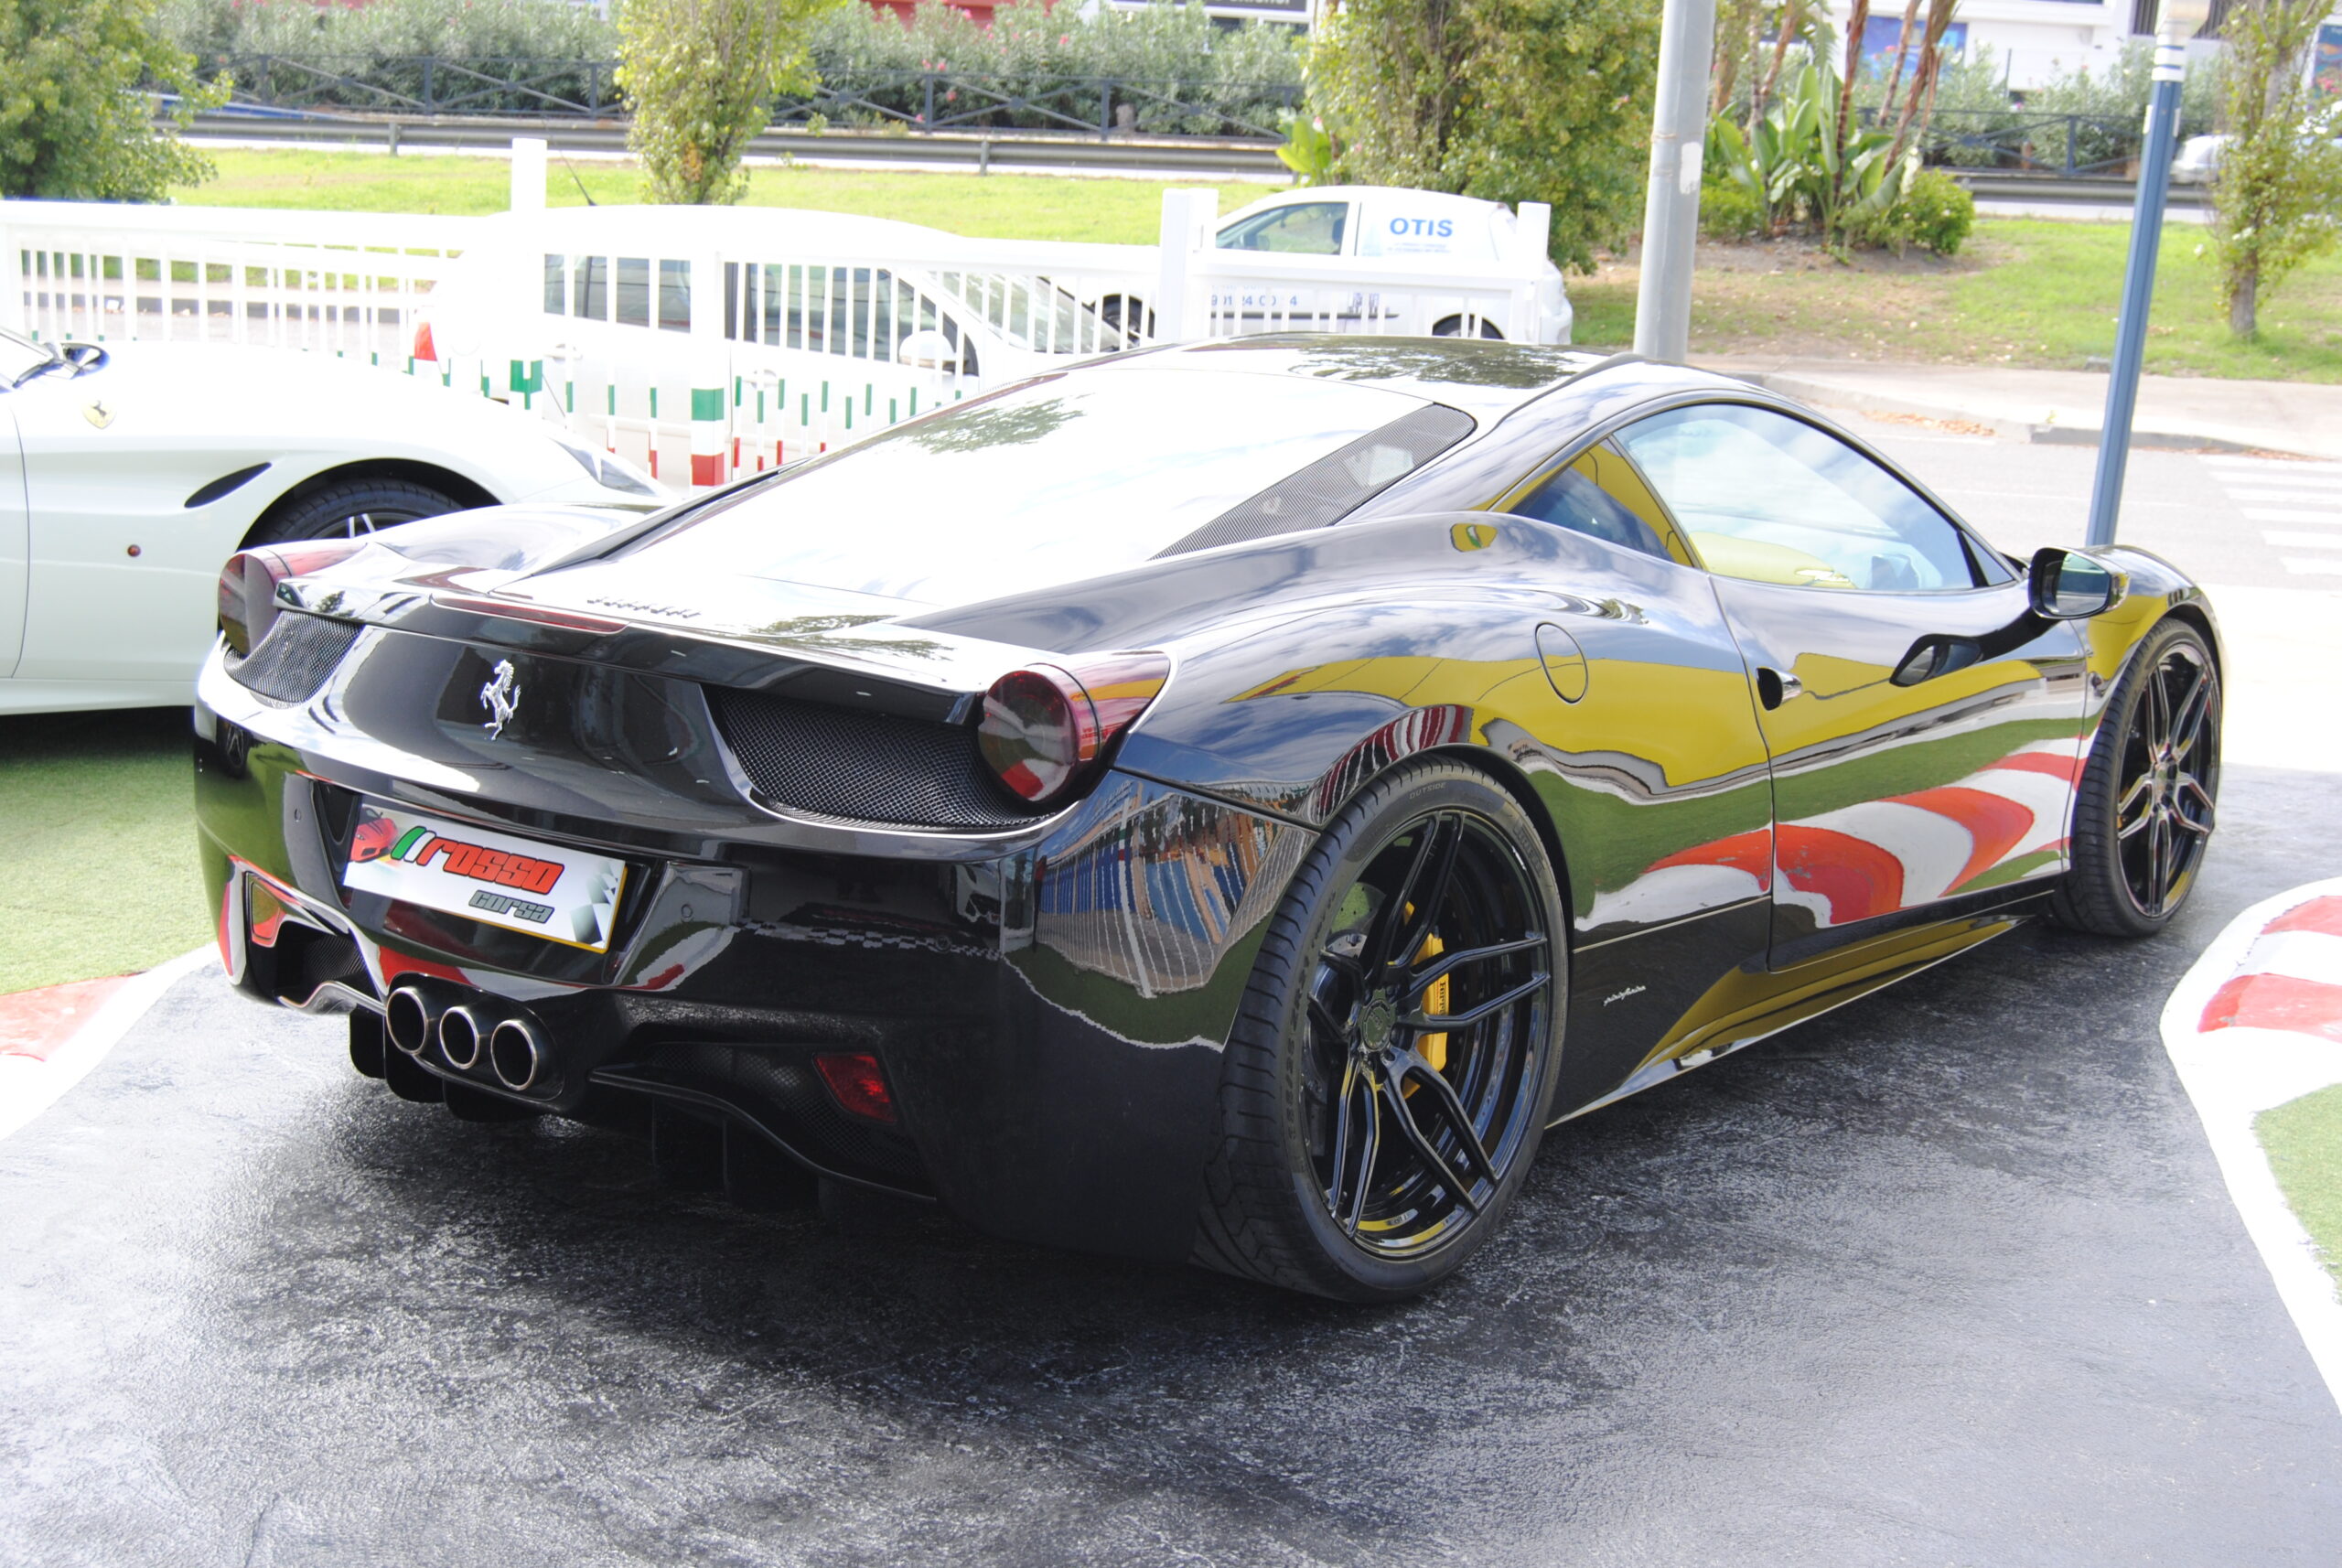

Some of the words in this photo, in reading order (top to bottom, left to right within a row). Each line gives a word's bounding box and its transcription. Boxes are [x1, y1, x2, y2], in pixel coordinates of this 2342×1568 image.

[1390, 217, 1453, 238] OTIS
[1409, 782, 1447, 800] OUTSIDE
[416, 836, 564, 895] rosso
[468, 889, 554, 924] corsa
